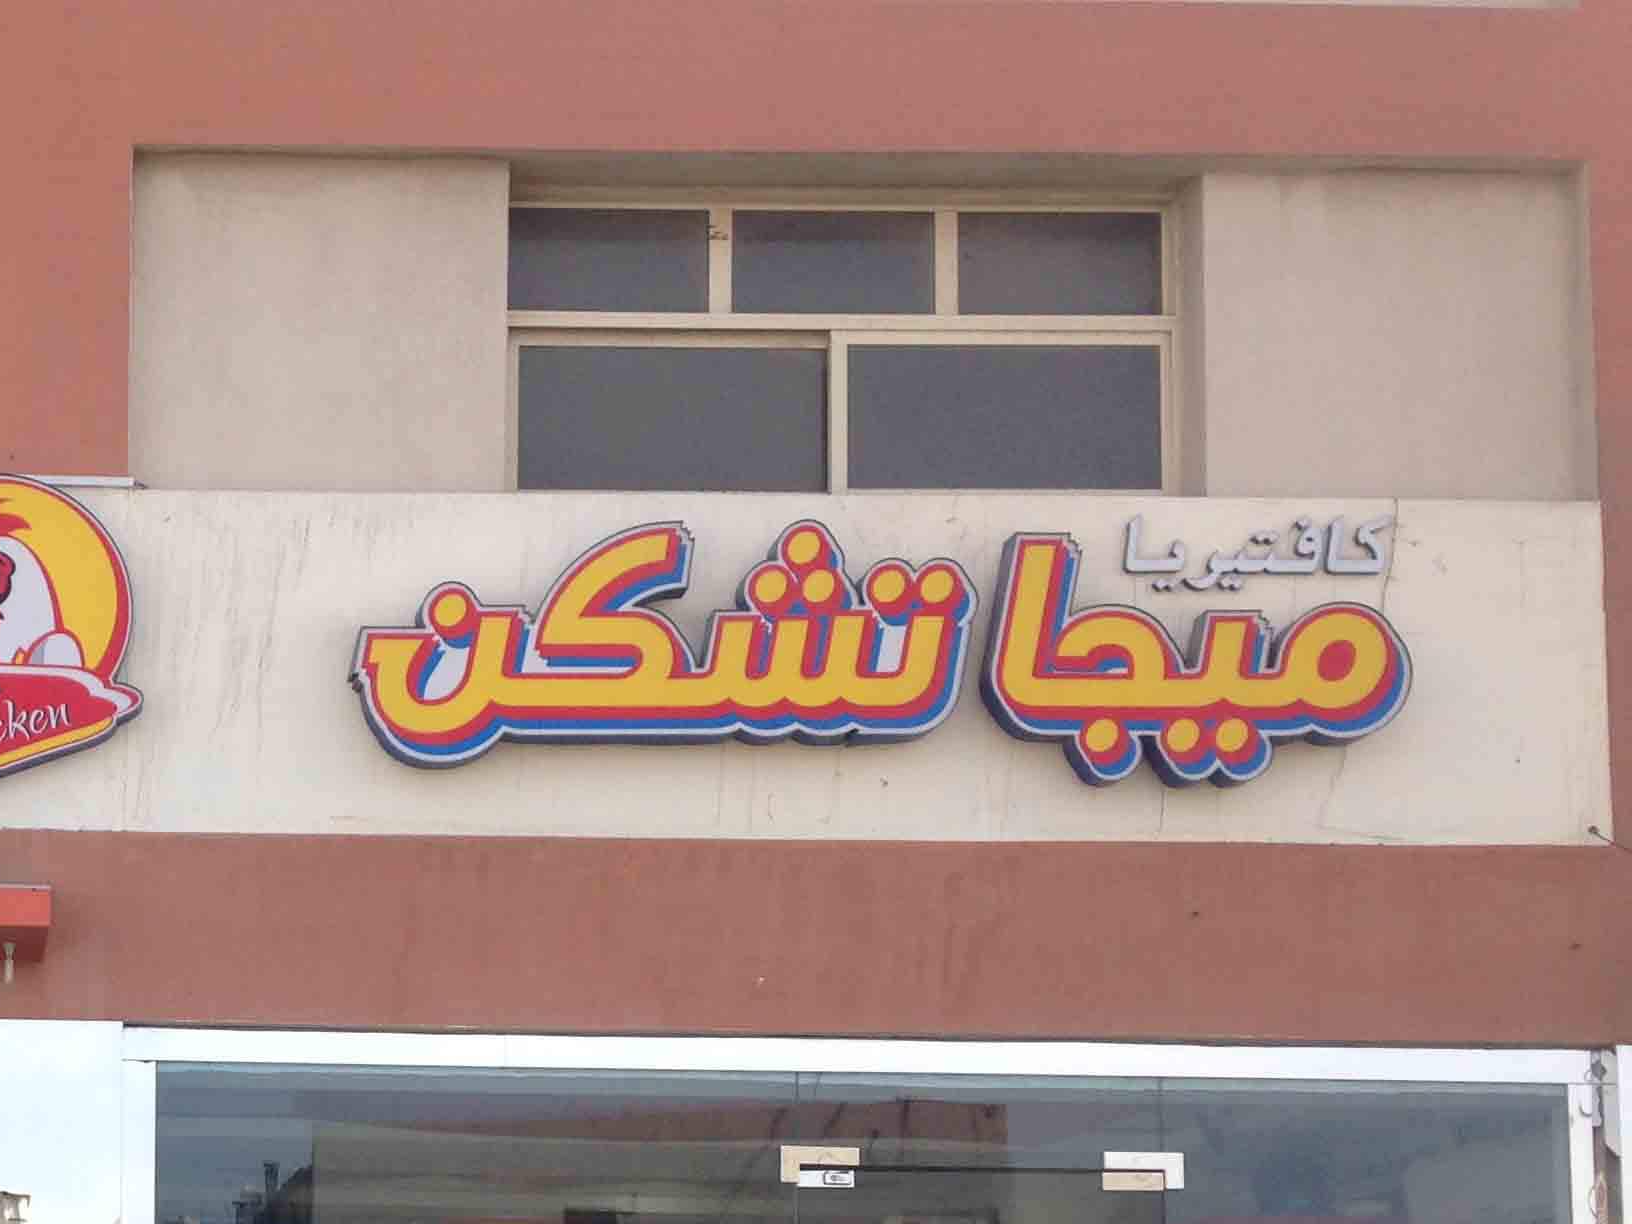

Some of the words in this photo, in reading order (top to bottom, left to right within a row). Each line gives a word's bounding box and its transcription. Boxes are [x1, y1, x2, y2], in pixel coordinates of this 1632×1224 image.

[350, 519, 977, 768] تشكن
[982, 531, 1412, 786] ميجا
[1122, 515, 1394, 591] كافتيريا
